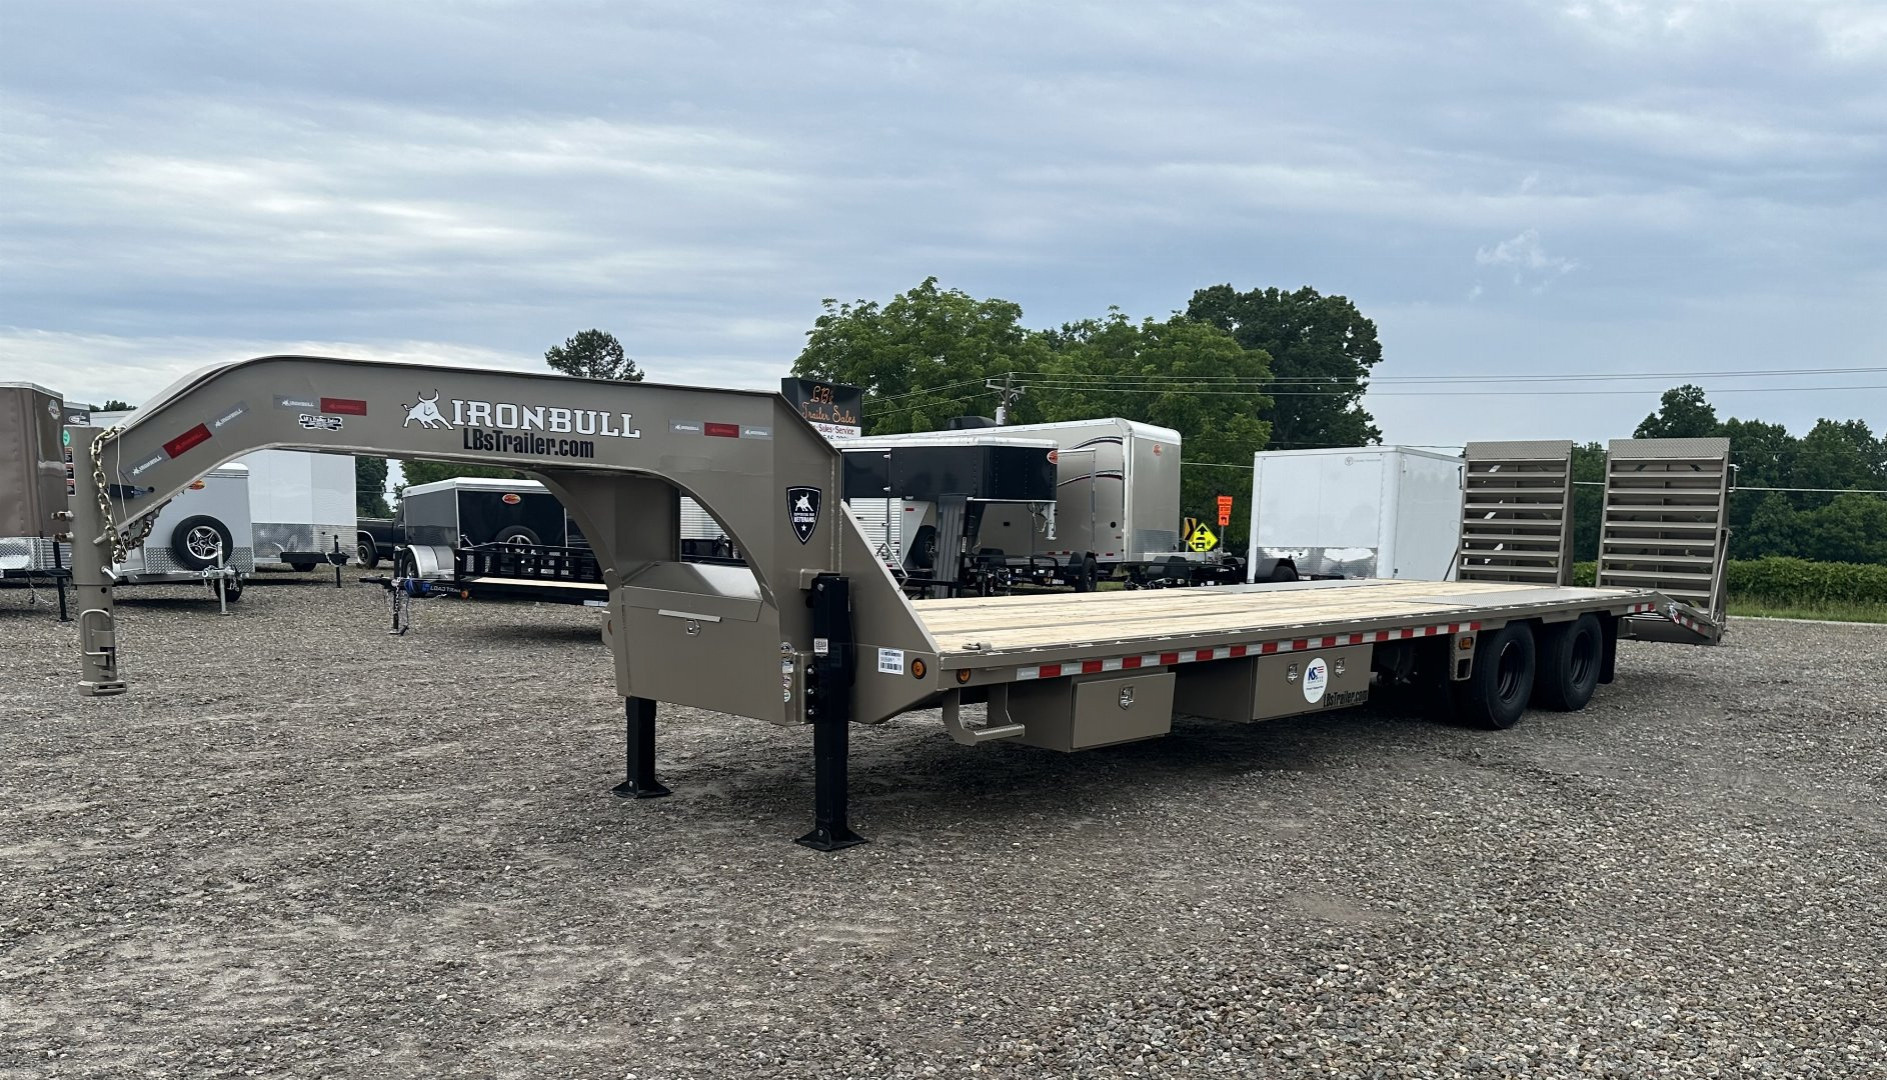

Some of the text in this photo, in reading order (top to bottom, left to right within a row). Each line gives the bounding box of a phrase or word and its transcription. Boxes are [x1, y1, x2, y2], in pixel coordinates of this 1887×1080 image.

[451, 399, 641, 439] IRONBULL
[802, 402, 856, 423] Trailer Sales
[463, 428, 594, 458] LBsTrailer.com
